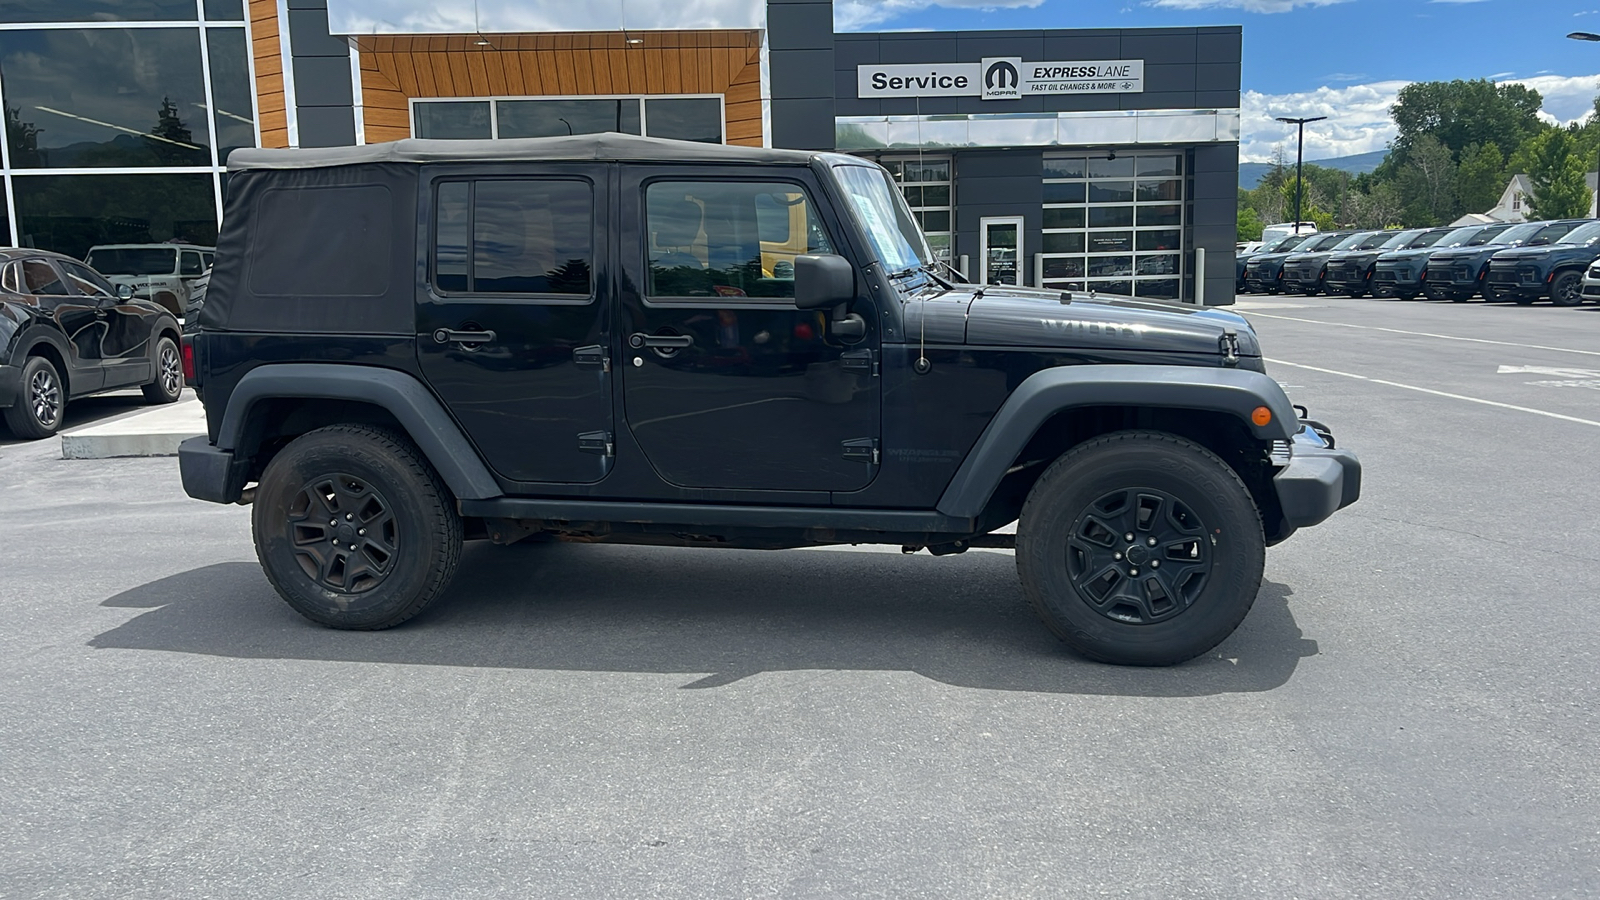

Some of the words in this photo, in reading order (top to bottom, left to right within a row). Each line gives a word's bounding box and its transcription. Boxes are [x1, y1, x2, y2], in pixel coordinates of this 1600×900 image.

[872, 72, 968, 90] Service
[1048, 83, 1058, 91] OIL
[1097, 82, 1116, 90] MORE
